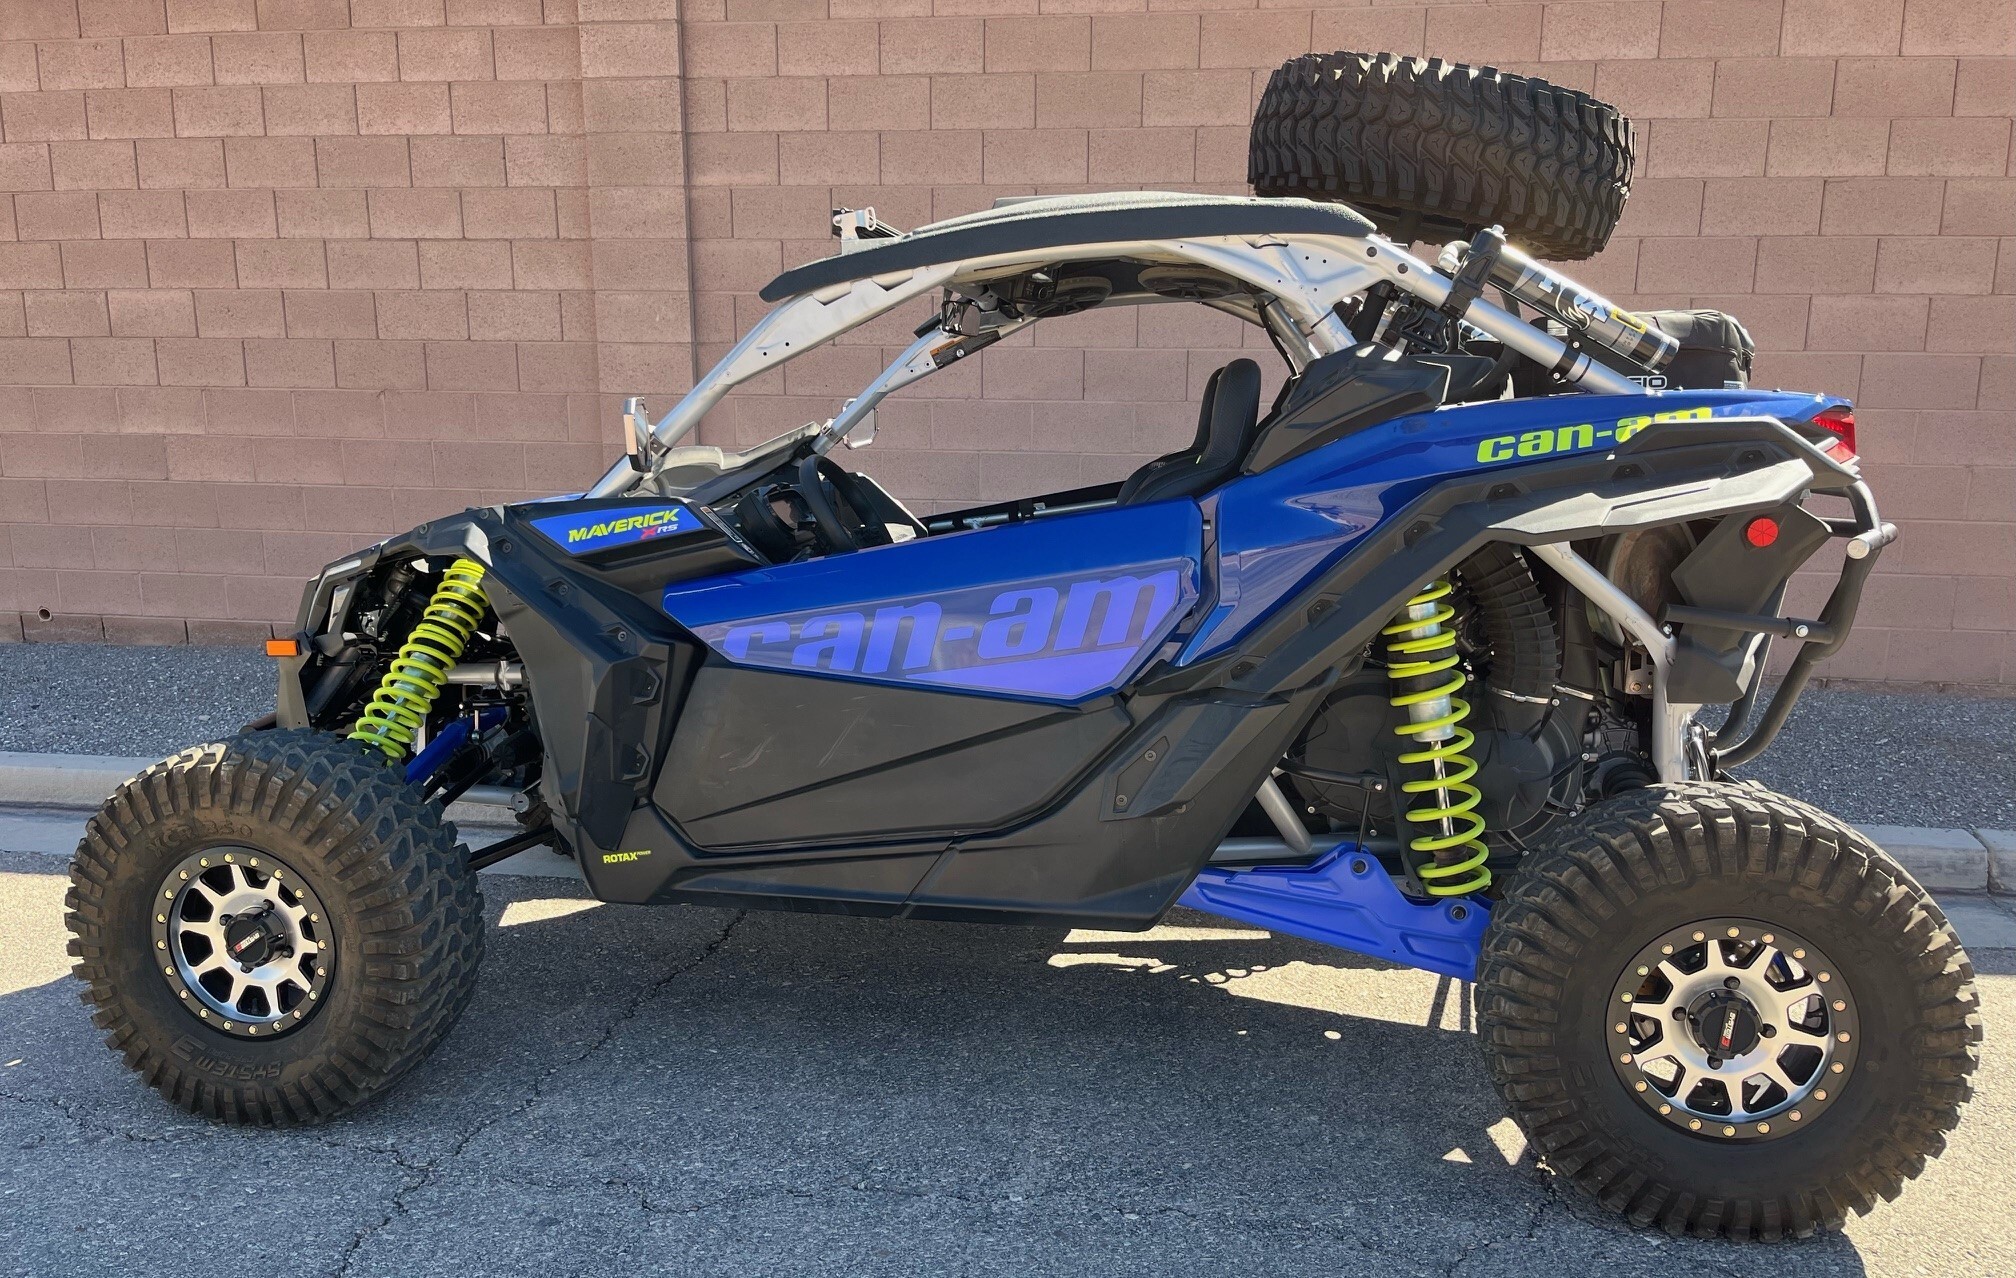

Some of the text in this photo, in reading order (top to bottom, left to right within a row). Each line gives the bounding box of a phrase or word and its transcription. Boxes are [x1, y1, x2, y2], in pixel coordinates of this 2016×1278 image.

[568, 508, 680, 543] MAVERICK
[723, 569, 1181, 674] can-am
[602, 852, 638, 864] ROTAX
[193, 1055, 283, 1082] SYSTEM
